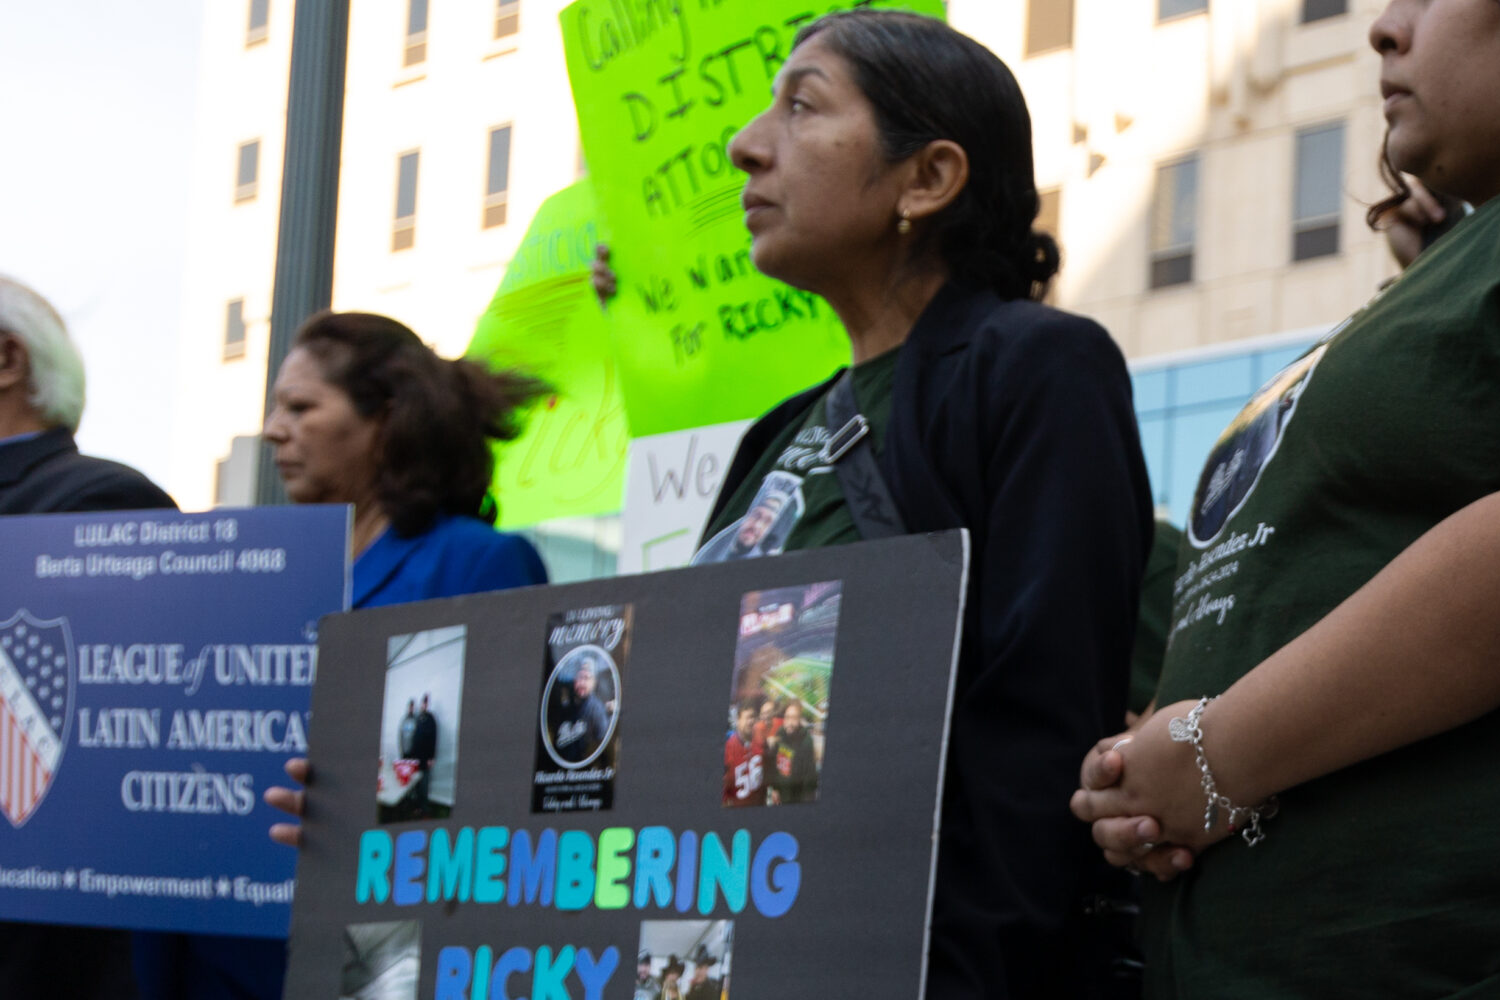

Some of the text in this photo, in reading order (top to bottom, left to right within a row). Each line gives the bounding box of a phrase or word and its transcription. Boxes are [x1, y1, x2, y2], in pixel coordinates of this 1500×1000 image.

[621, 0, 892, 143] DISTR
[686, 236, 752, 291] Wan
[647, 433, 720, 505] We
[74, 522, 138, 547] LULAC
[140, 520, 210, 544] District
[160, 550, 234, 574] Council
[78, 645, 183, 685] LEAGUE
[183, 643, 213, 695] of
[78, 708, 313, 752] LATIN AMERICA
[121, 770, 256, 815] CITIZENS
[0, 868, 60, 889] ucation
[80, 868, 213, 898] Empowerment
[356, 826, 801, 918] REMEMBERING
